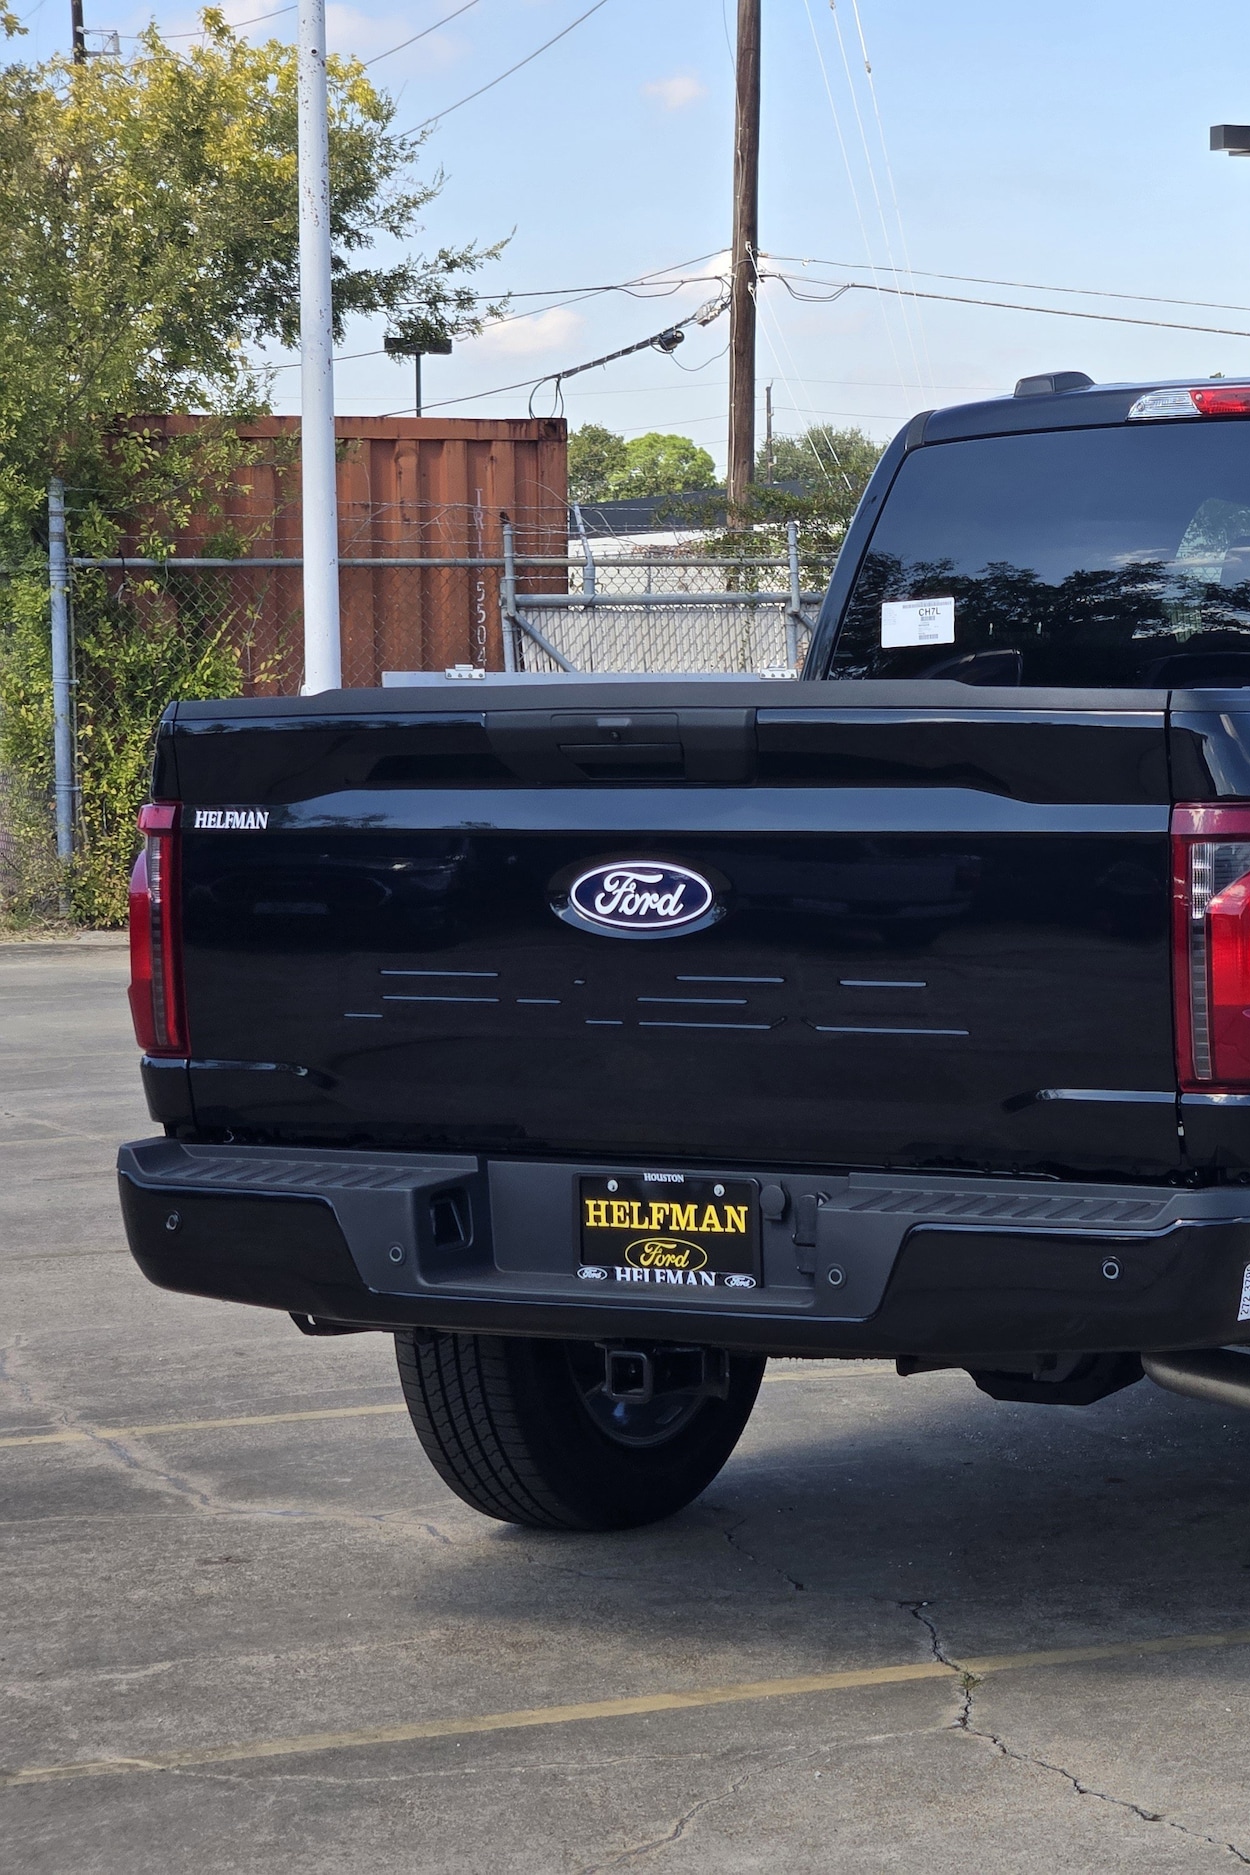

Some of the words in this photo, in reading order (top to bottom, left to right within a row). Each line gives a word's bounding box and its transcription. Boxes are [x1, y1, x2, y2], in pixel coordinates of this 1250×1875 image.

[918, 607, 941, 617] CH7L
[476, 581, 487, 666] 5504
[194, 810, 269, 829] HELFMAN
[594, 871, 686, 917] Ford
[643, 1172, 685, 1183] HOUSTON
[585, 1199, 748, 1234] HELFMAN
[639, 1241, 691, 1268] Ford
[615, 1266, 717, 1287] HELFMAN
[1240, 1295, 1250, 1315] 272
